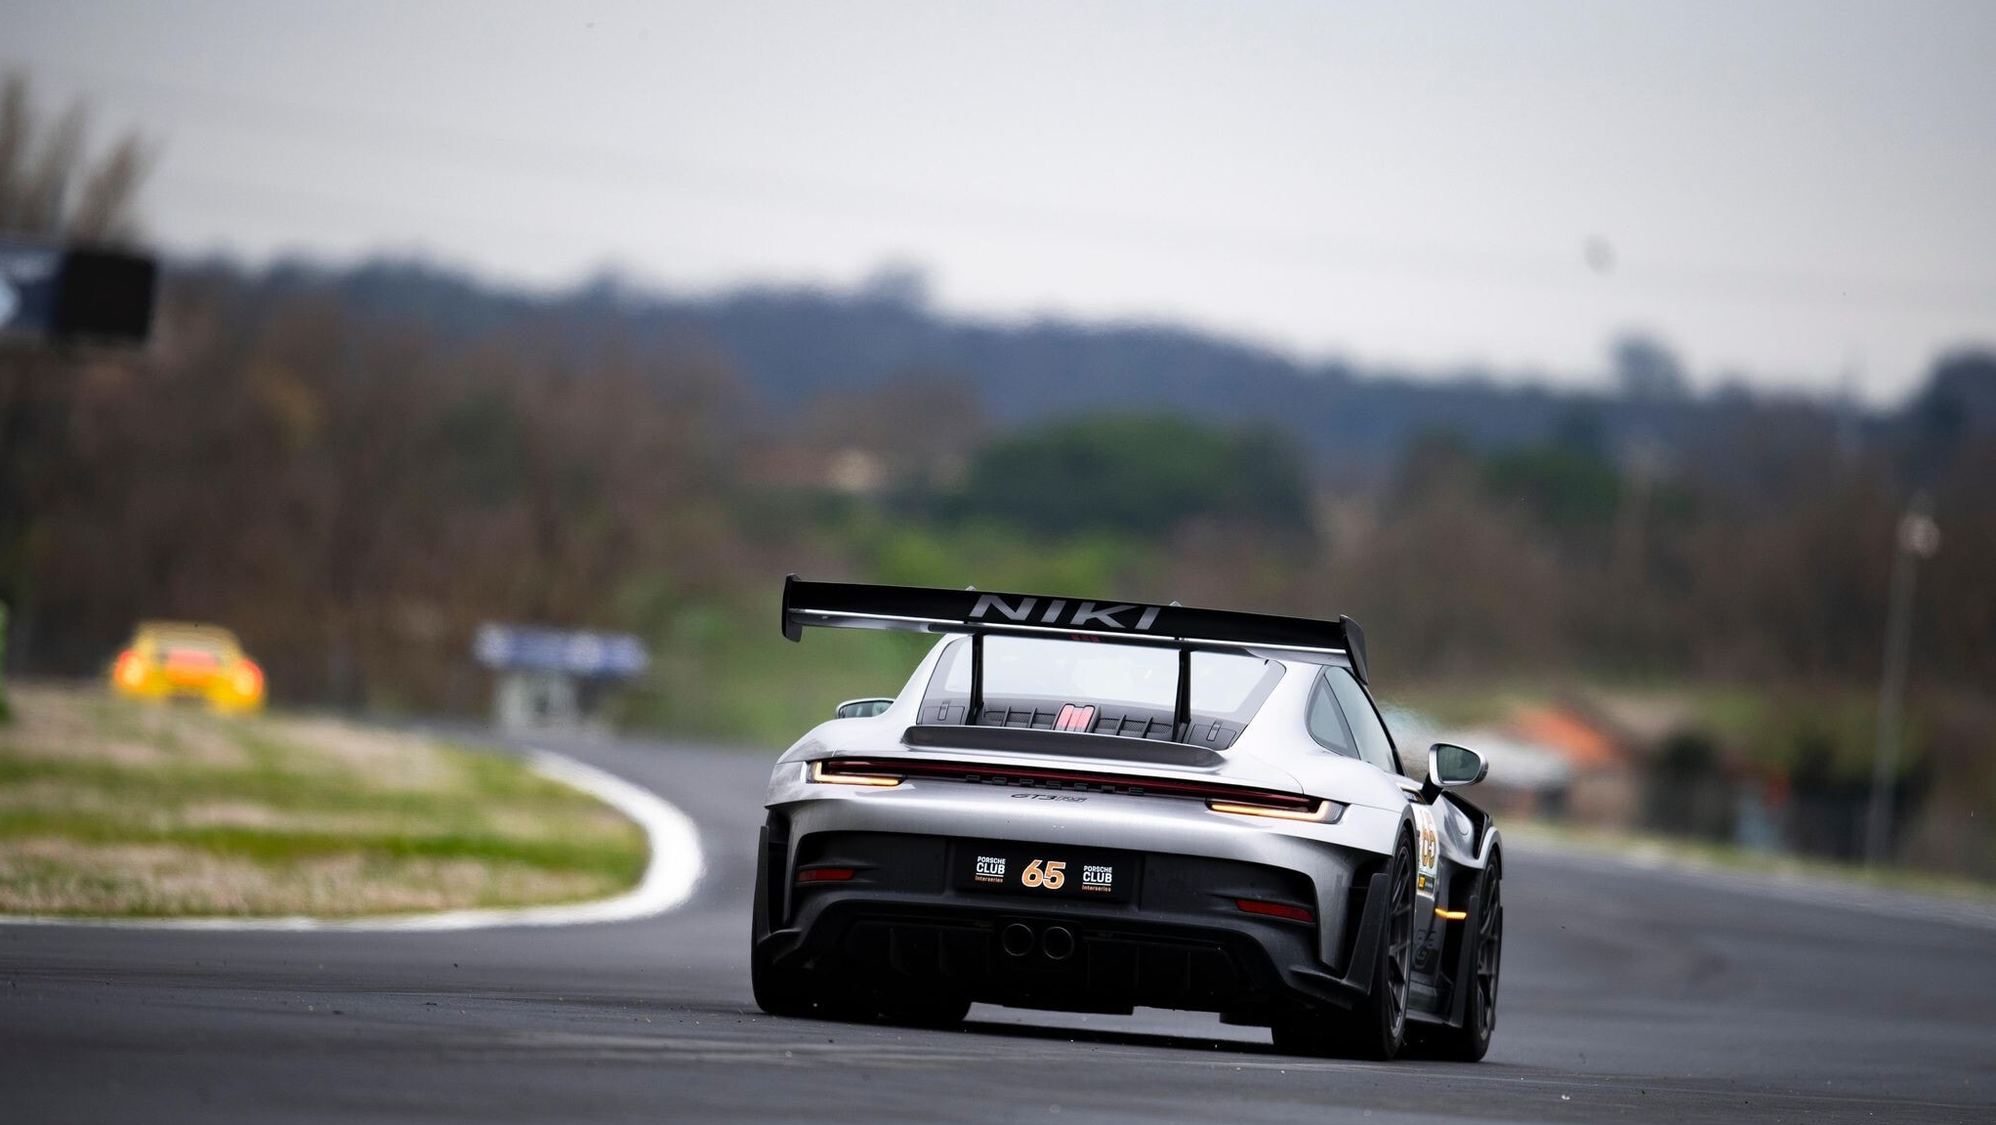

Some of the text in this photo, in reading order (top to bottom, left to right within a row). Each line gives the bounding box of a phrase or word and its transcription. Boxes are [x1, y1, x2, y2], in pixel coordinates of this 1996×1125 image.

[969, 594, 1161, 630] NIKI
[977, 855, 1006, 865] PORSCHE
[976, 862, 1005, 875] CLUB
[1021, 859, 1066, 890] 65
[1083, 865, 1112, 873] PORSCHE
[1082, 871, 1112, 883] CLUB
